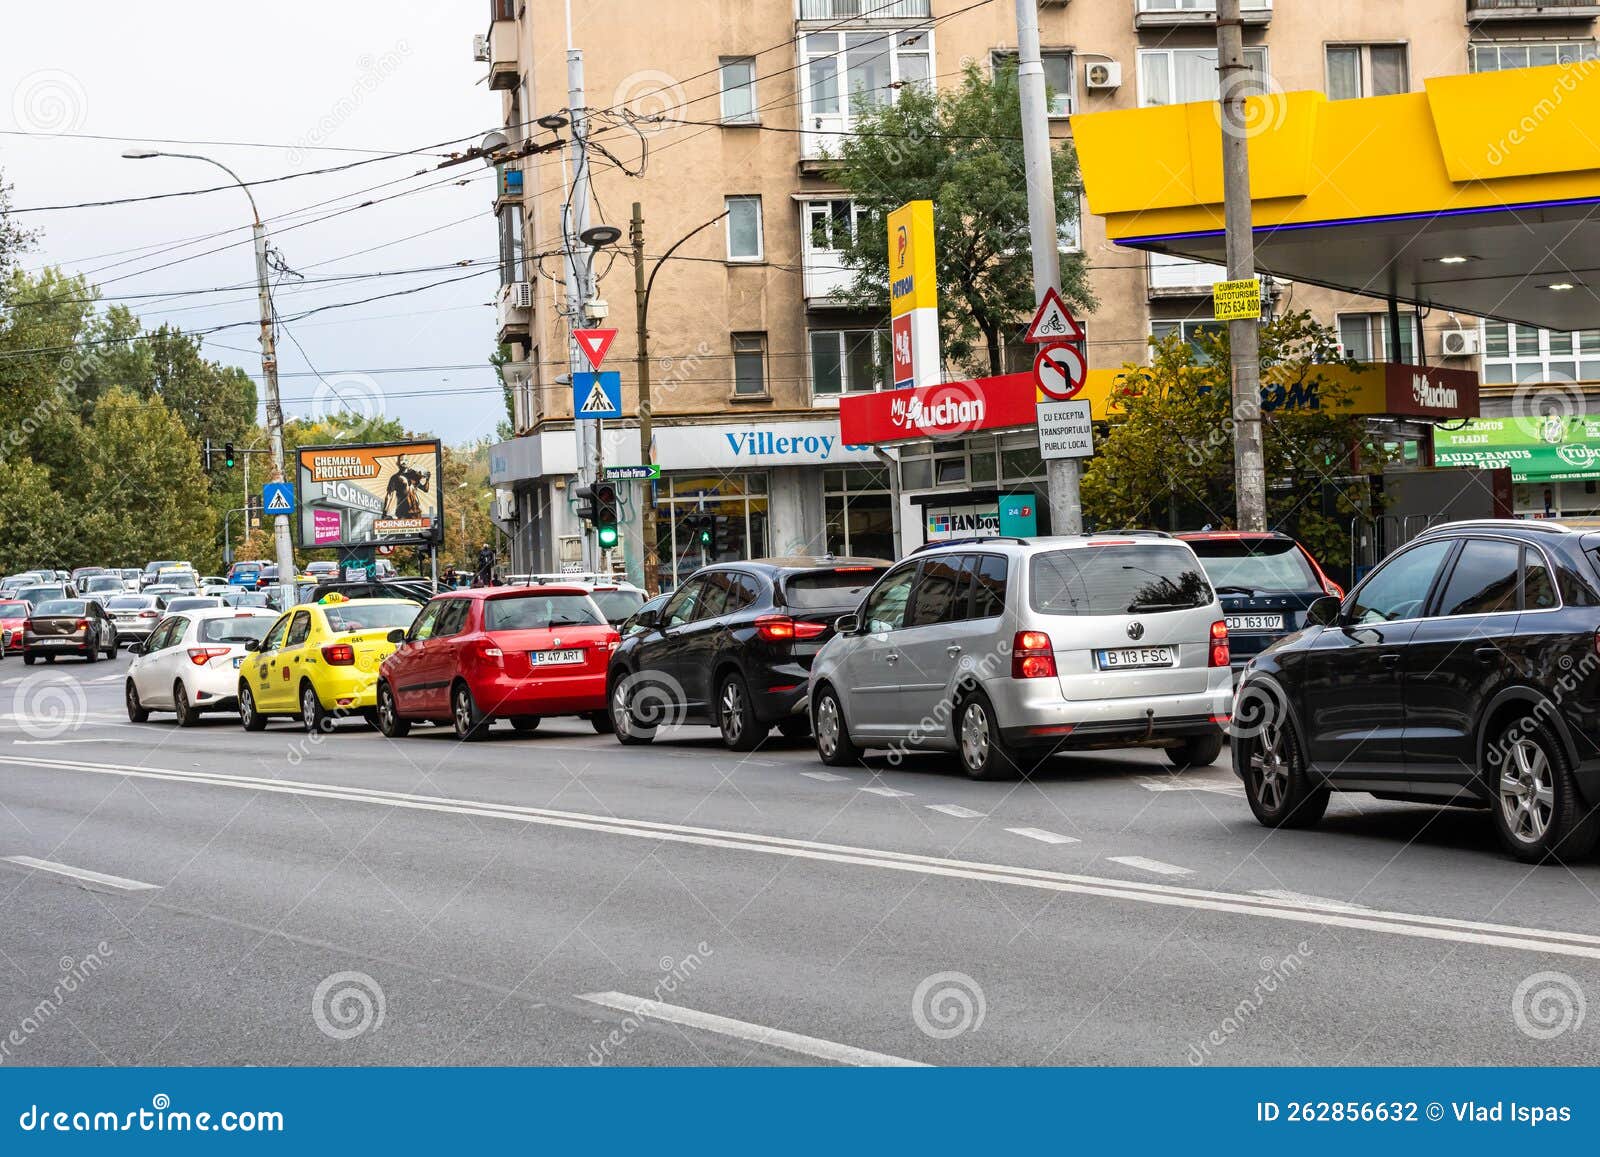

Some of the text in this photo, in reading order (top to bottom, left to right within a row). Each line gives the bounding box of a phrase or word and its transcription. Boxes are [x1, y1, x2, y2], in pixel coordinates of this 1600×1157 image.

[1219, 282, 1253, 291] CUMPARAM
[1215, 290, 1258, 300] AUTOTURISME
[1216, 299, 1259, 314] 0725 634 800
[1053, 411, 1084, 421] EXCEPTIA
[1040, 425, 1090, 436] TRANSPORTULUI
[1451, 434, 1488, 443] TRADE
[725, 431, 835, 459] Villeroy
[1044, 440, 1088, 450] PUBLIC LOCAL
[314, 457, 361, 466] CHEMAREA
[315, 465, 374, 478] PROIECTULUI
[322, 481, 382, 511] HORNBACH
[1008, 508, 1019, 516] 24
[375, 519, 422, 529] HORNBACH
[1225, 616, 1241, 629] CD
[538, 651, 580, 662] B 417 ART
[1108, 649, 1168, 664] B 113 FSC
